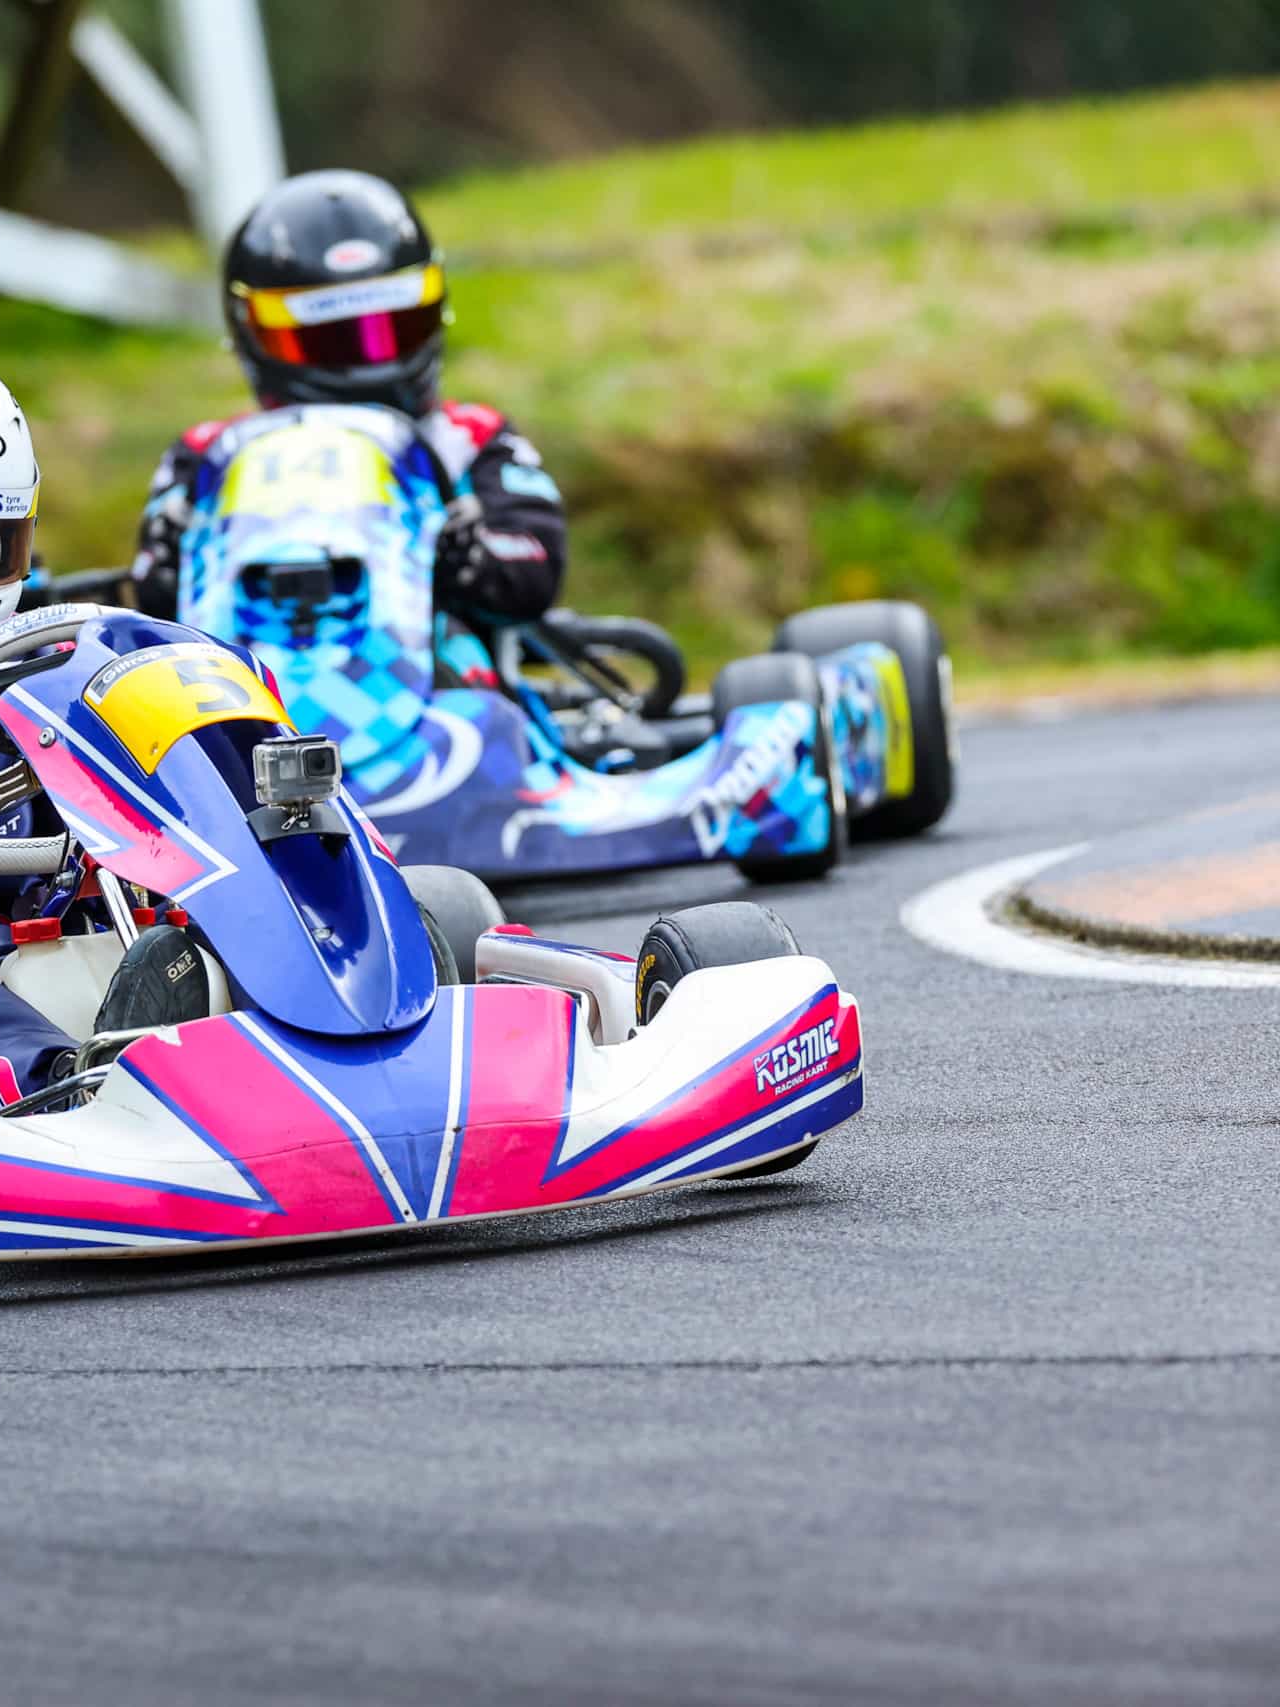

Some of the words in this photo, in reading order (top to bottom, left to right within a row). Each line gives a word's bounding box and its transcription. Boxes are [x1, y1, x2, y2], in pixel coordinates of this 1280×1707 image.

[6, 495, 21, 504] tyre
[175, 659, 251, 713] 5
[167, 953, 192, 979] OMP
[754, 1018, 839, 1092] KOSMIC
[775, 1075, 804, 1095] RACING
[805, 1061, 828, 1080] KART
